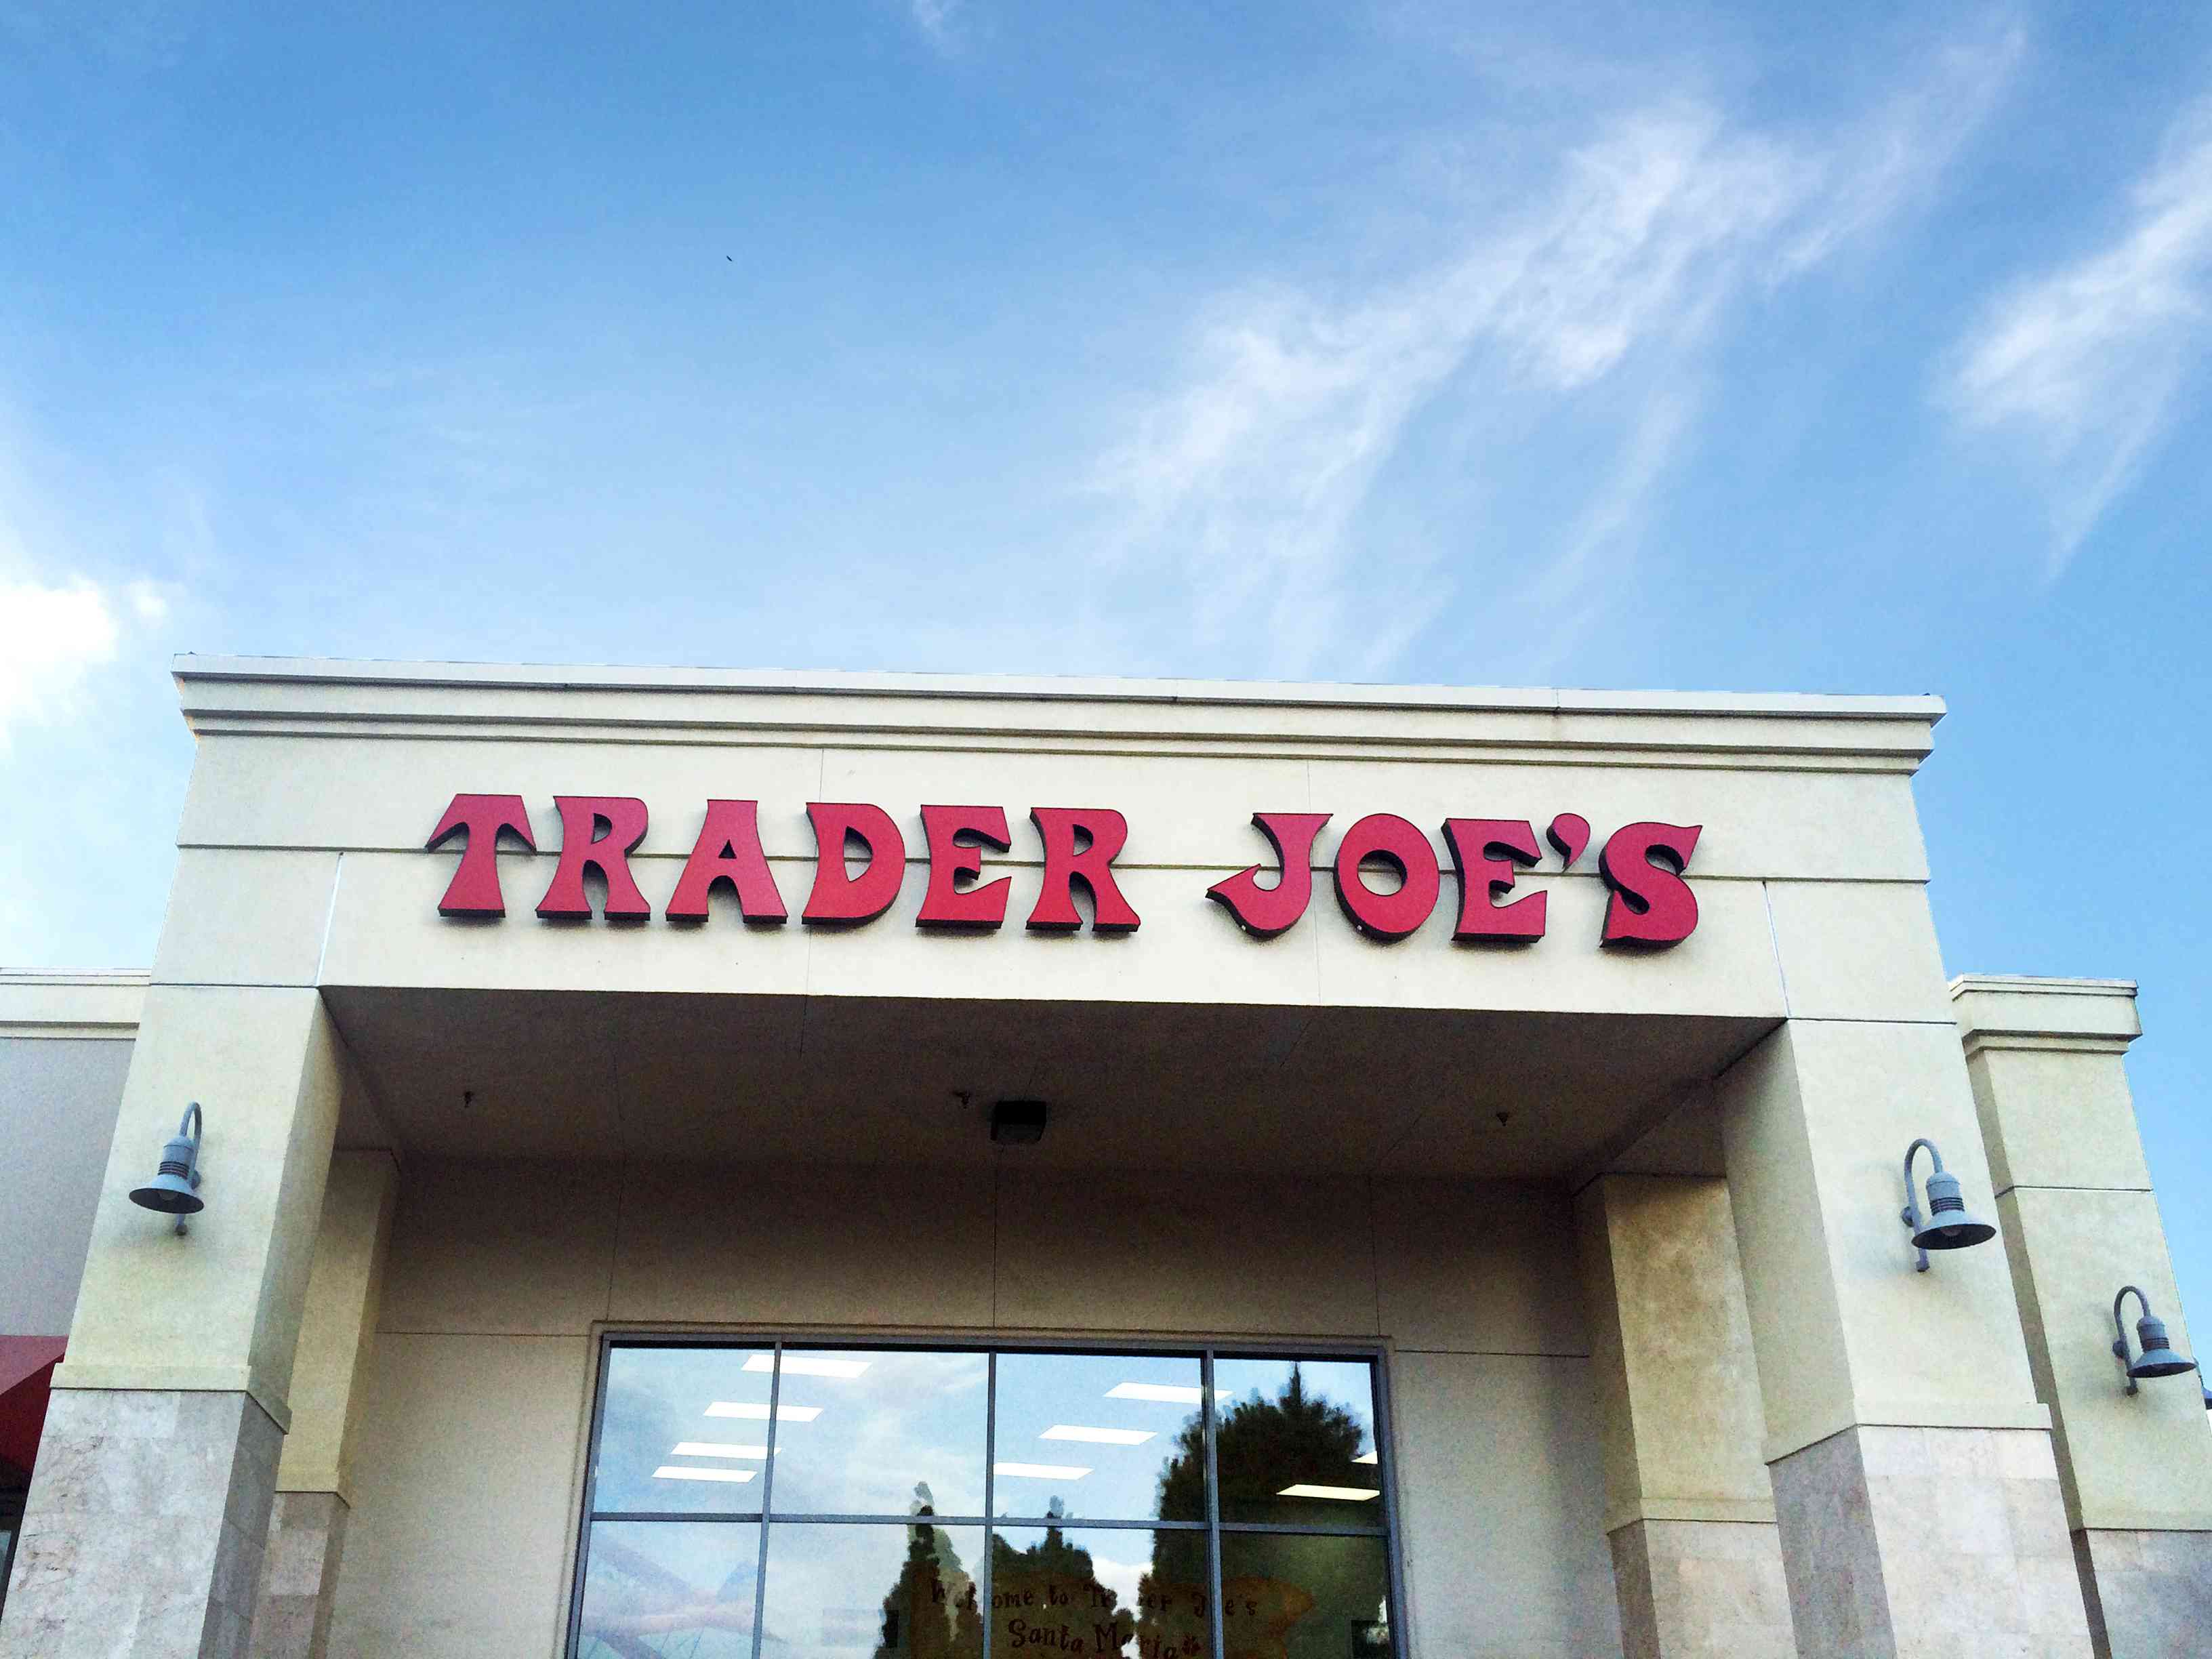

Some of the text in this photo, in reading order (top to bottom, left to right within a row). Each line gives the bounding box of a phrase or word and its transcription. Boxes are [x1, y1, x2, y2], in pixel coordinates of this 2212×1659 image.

[424, 793, 1703, 949] TRADER JOE'S
[1049, 1584, 1069, 1605] to
[1191, 1593, 1258, 1618] Je's
[1008, 1618, 1084, 1654] Santa
